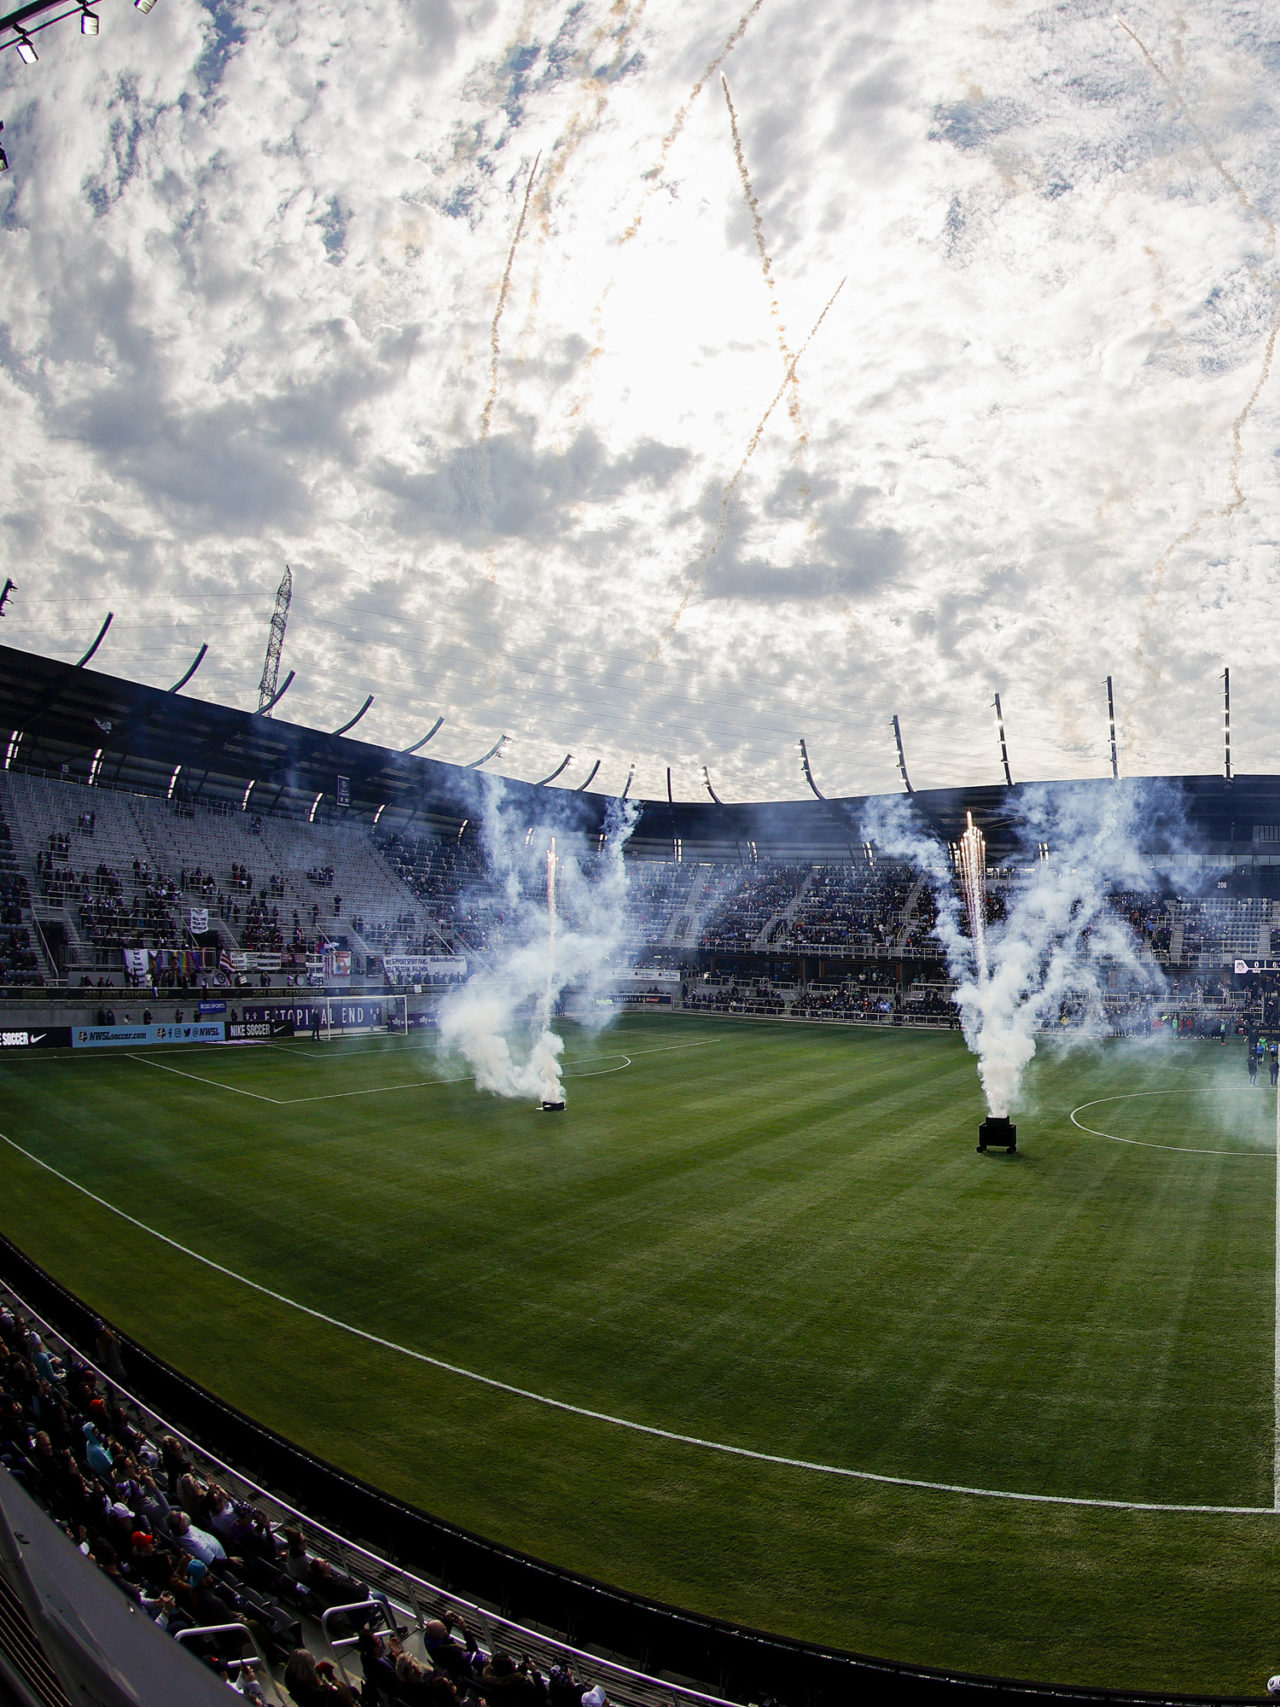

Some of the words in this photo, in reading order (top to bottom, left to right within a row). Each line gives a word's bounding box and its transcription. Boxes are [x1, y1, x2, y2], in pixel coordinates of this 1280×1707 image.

[342, 1008, 364, 1024] END
[90, 1032, 146, 1040] NWSLsoccer.com
[192, 1027, 219, 1036] @NWSL
[230, 1024, 245, 1036] NIKE
[247, 1024, 270, 1035] SOCCER
[3, 1032, 29, 1045] SOCCER
